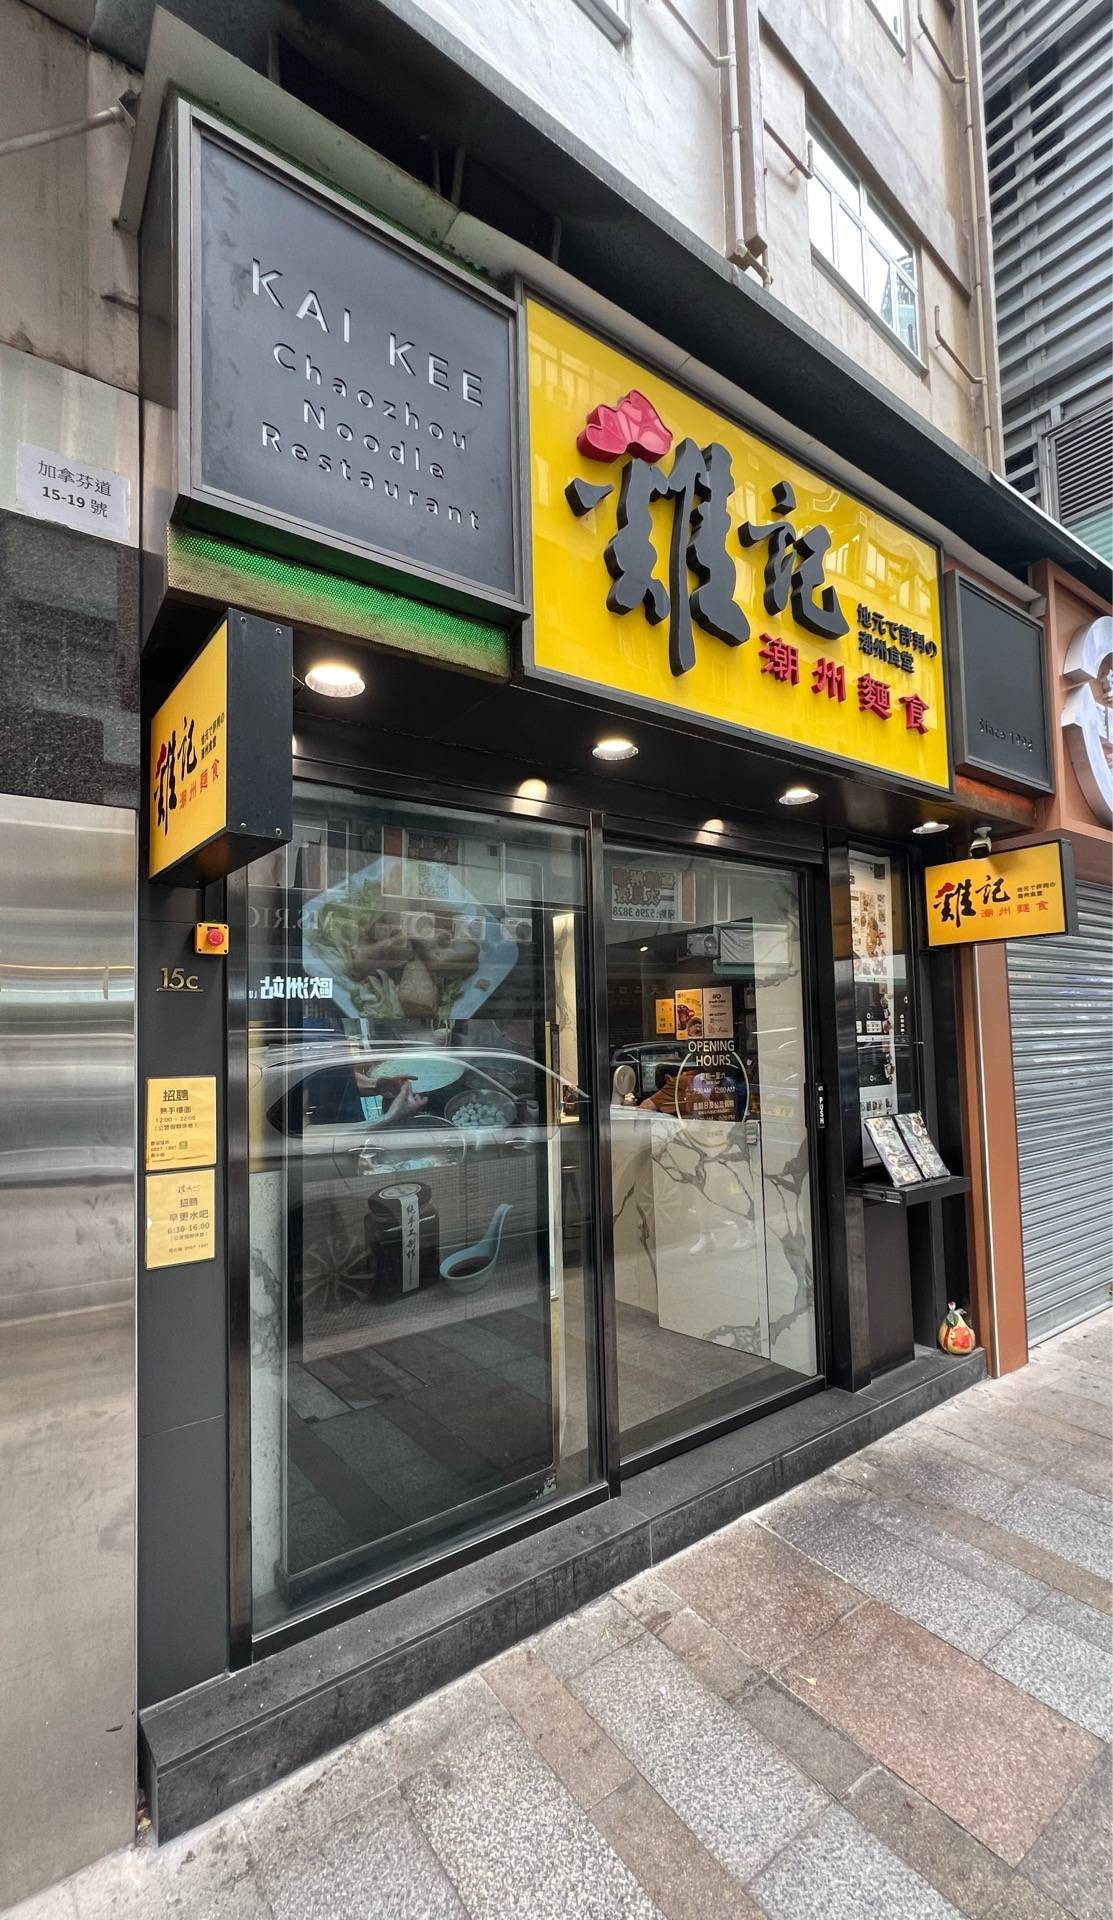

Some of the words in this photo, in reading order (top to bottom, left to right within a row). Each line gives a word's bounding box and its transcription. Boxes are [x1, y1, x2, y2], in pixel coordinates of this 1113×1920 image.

[252, 257, 350, 343] KAI
[389, 332, 483, 407] KEE
[273, 342, 466, 450] Chaozhou
[304, 399, 444, 479] Noodle
[38, 460, 111, 496] 加拿芬道
[262, 421, 479, 530] Restaurant
[42, 486, 85, 508] 15-19
[90, 499, 108, 518] 號
[758, 632, 930, 735] 潮州麵食
[979, 718, 1006, 740] Since
[160, 967, 198, 989] 15c
[688, 1040, 735, 1052] OPENING
[696, 1055, 731, 1066] HOURS
[163, 1089, 189, 1101] 招聘
